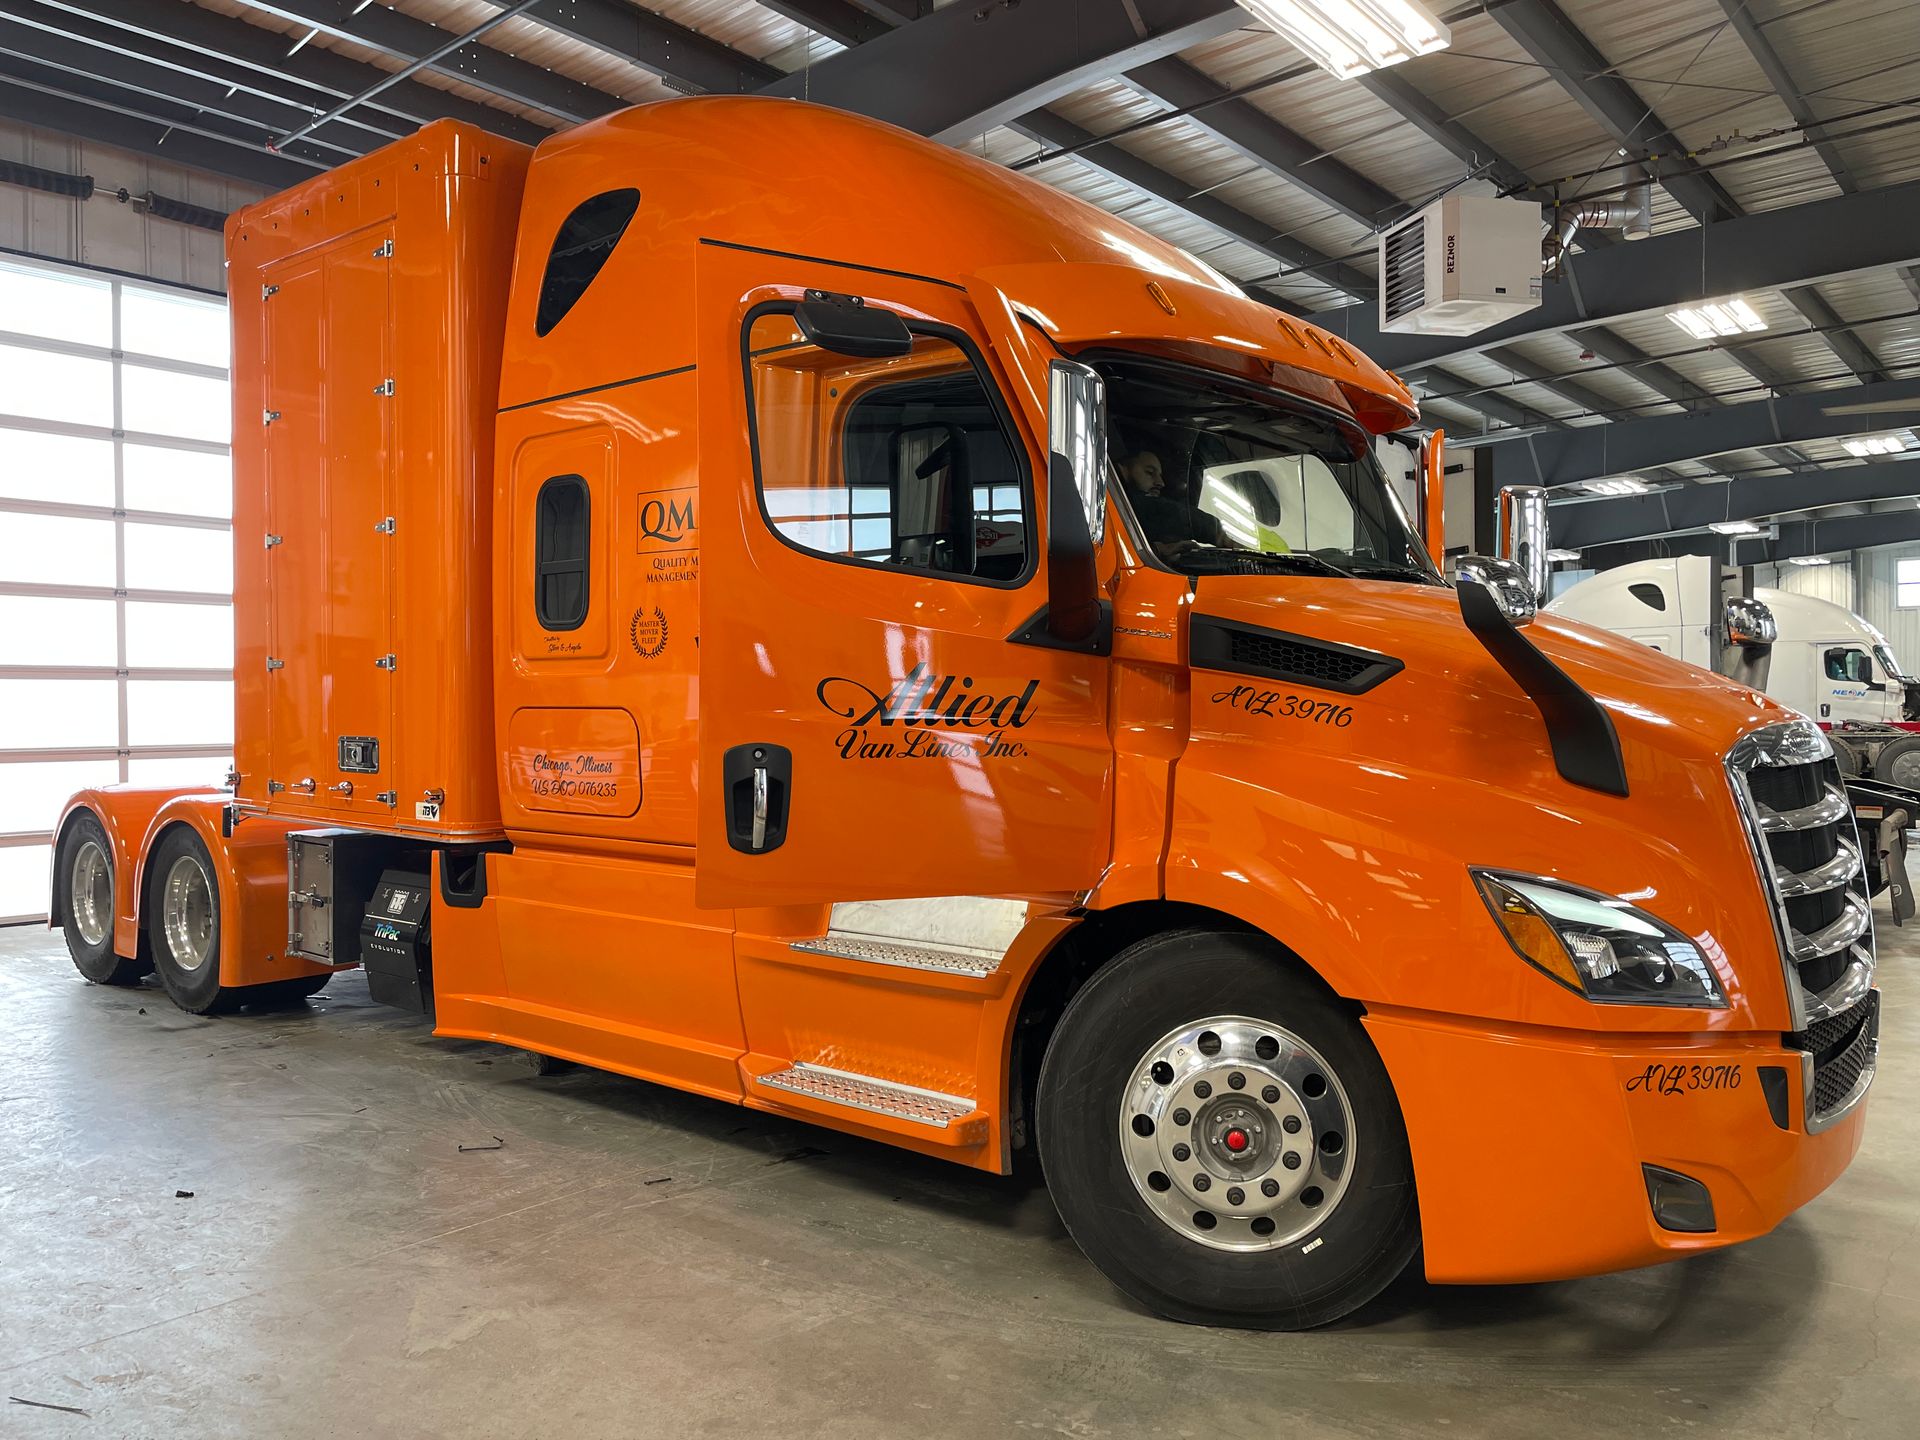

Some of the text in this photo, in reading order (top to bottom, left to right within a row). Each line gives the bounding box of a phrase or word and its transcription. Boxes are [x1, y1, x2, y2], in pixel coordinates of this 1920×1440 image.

[1446, 234, 1456, 274] REZNOR
[652, 557, 688, 571] QUALITY
[639, 620, 660, 628] MASTER
[639, 628, 659, 636] MOVER
[641, 637, 657, 645] FLEET
[816, 662, 1041, 729] Allied
[1279, 695, 1354, 728] 39716
[834, 729, 1029, 760] Van Lines Inc.
[533, 754, 612, 778] Chicago, Illinois
[578, 781, 617, 797] 076235
[374, 923, 401, 941] TriPac
[370, 943, 406, 955] EVOLUTION
[1687, 1065, 1741, 1090] 39716
